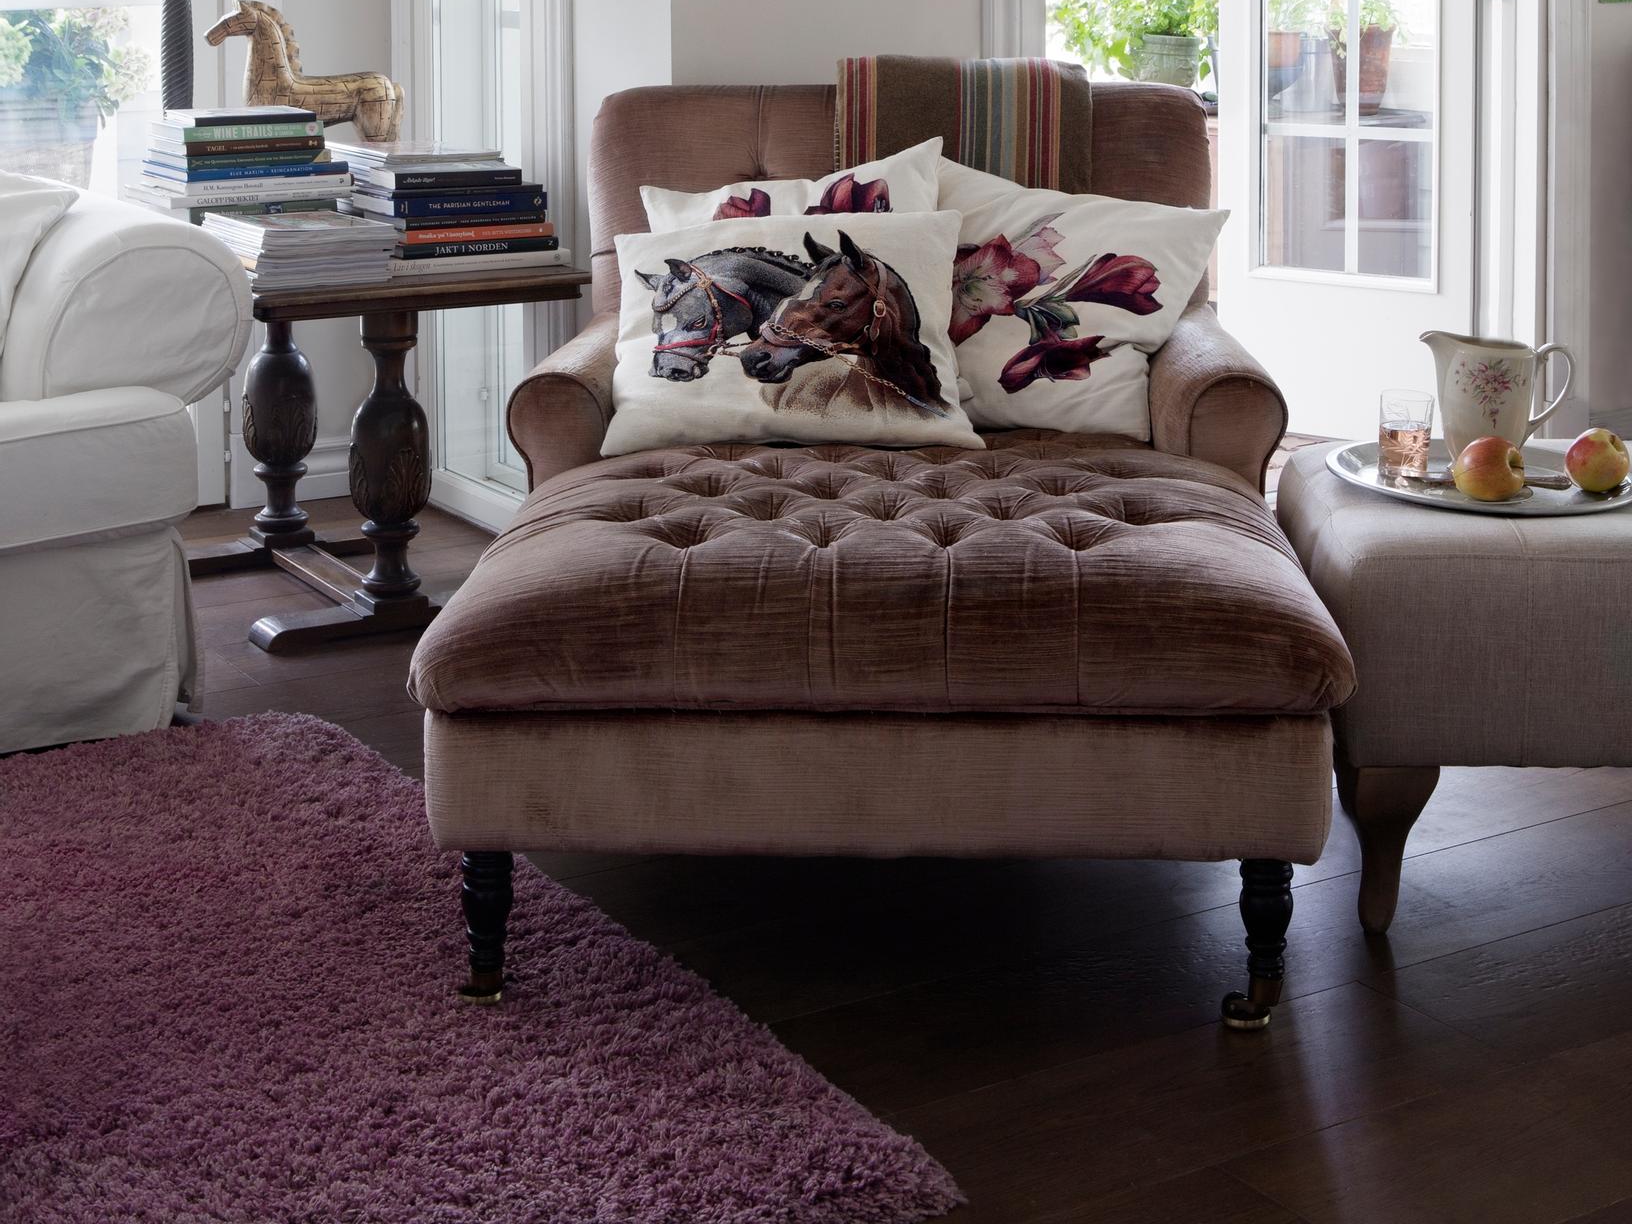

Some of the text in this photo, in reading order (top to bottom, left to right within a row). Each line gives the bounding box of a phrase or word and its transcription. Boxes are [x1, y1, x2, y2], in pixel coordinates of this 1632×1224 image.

[213, 127, 238, 140] WINE
[241, 124, 273, 138] TRAILS
[443, 201, 471, 209] PARISIAN
[473, 200, 510, 208] GENTLEMAN
[434, 242, 509, 256] JAKT I NORDEN
